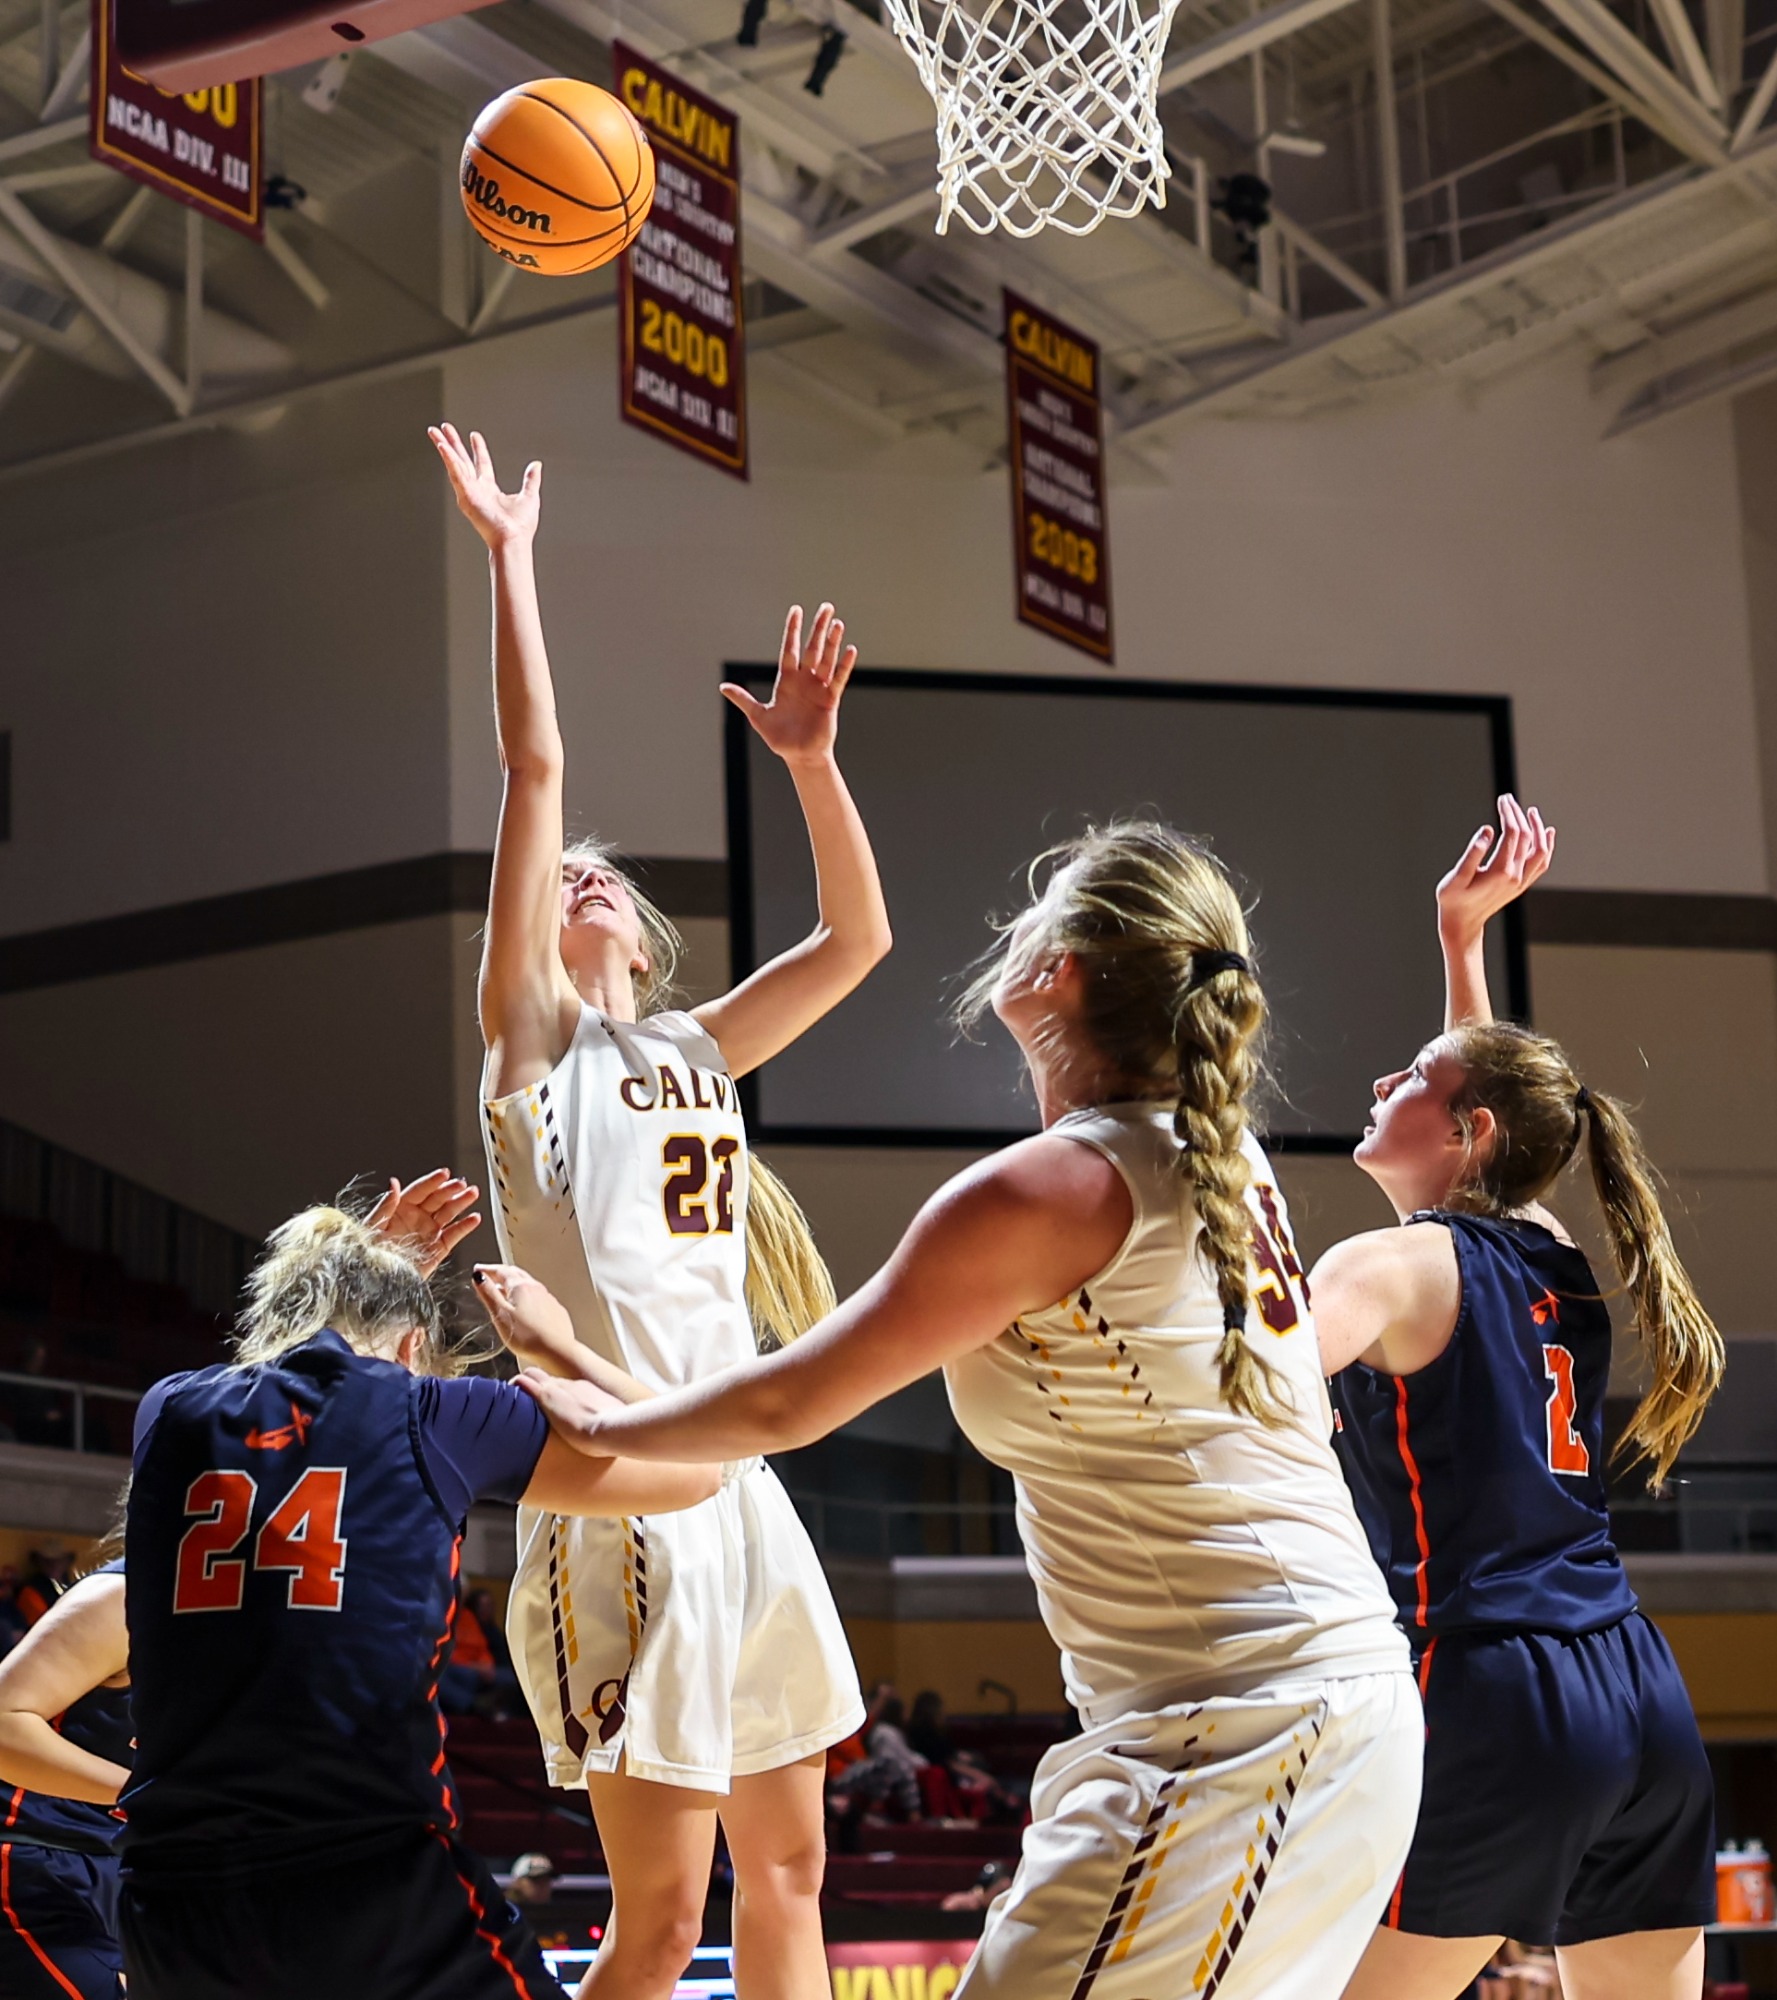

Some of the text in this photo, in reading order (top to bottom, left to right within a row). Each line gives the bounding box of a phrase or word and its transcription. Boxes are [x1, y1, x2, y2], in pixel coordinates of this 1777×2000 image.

[107, 93, 170, 153] NCAA
[173, 128, 218, 177] DIV.
[221, 152, 250, 193] III
[622, 68, 732, 169] CALVIN
[640, 299, 728, 388] 2000
[661, 1132, 738, 1238] 22
[1541, 1343, 1590, 1478] 2
[172, 1466, 348, 1615] 24
